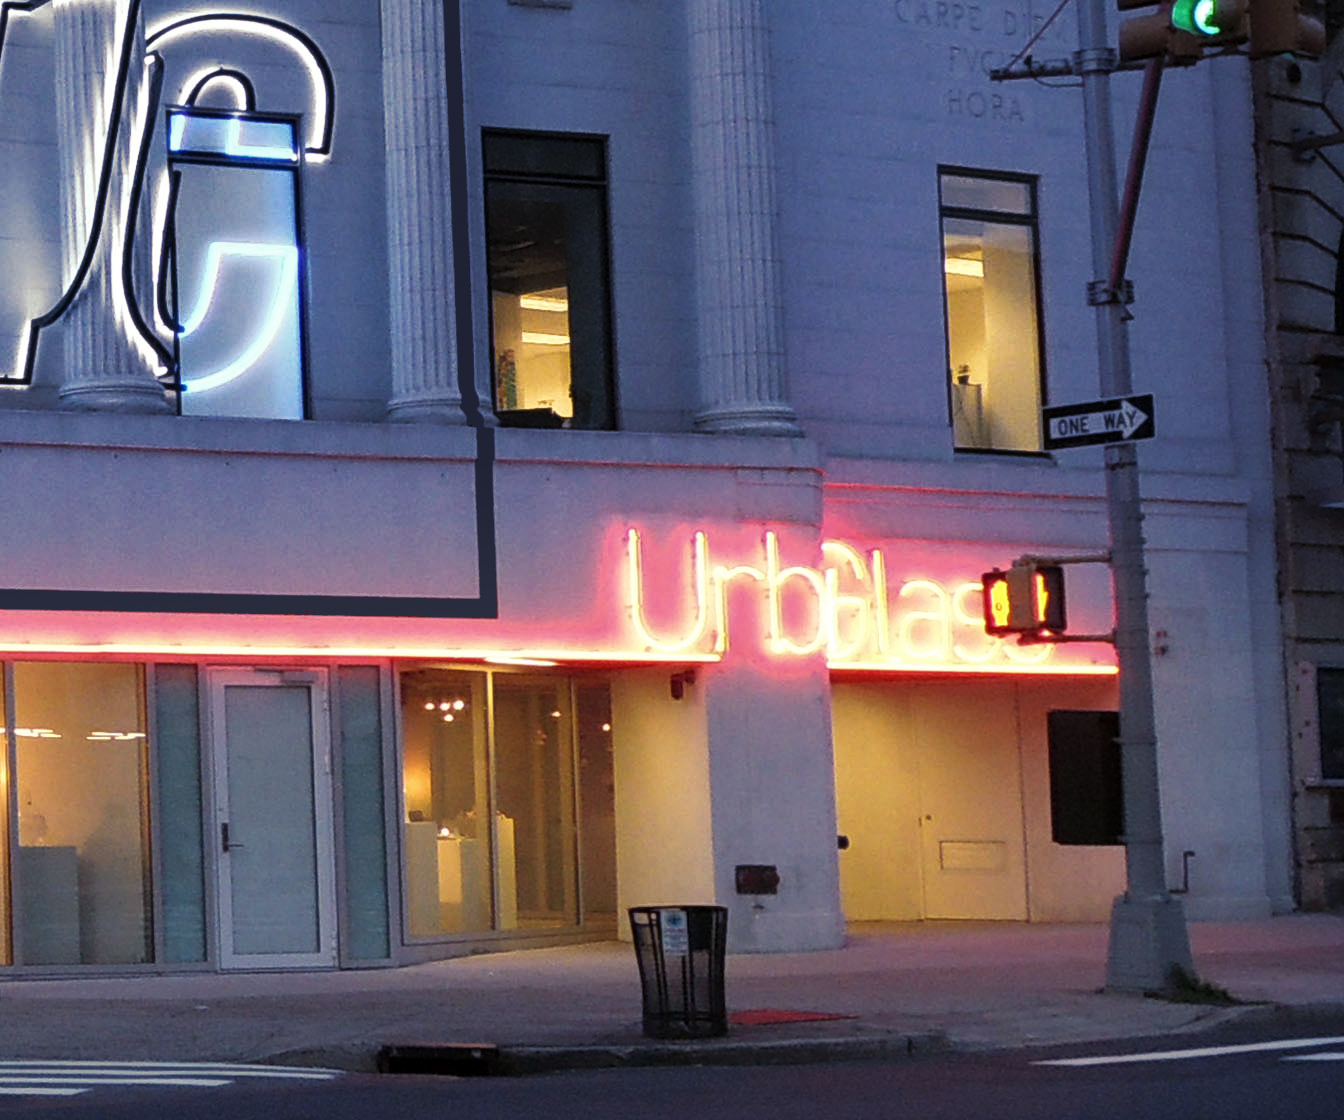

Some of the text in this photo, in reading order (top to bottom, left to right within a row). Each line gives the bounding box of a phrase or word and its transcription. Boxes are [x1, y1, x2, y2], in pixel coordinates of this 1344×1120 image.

[946, 88, 1025, 122] HORA
[1057, 410, 1137, 436] ONE WAY
